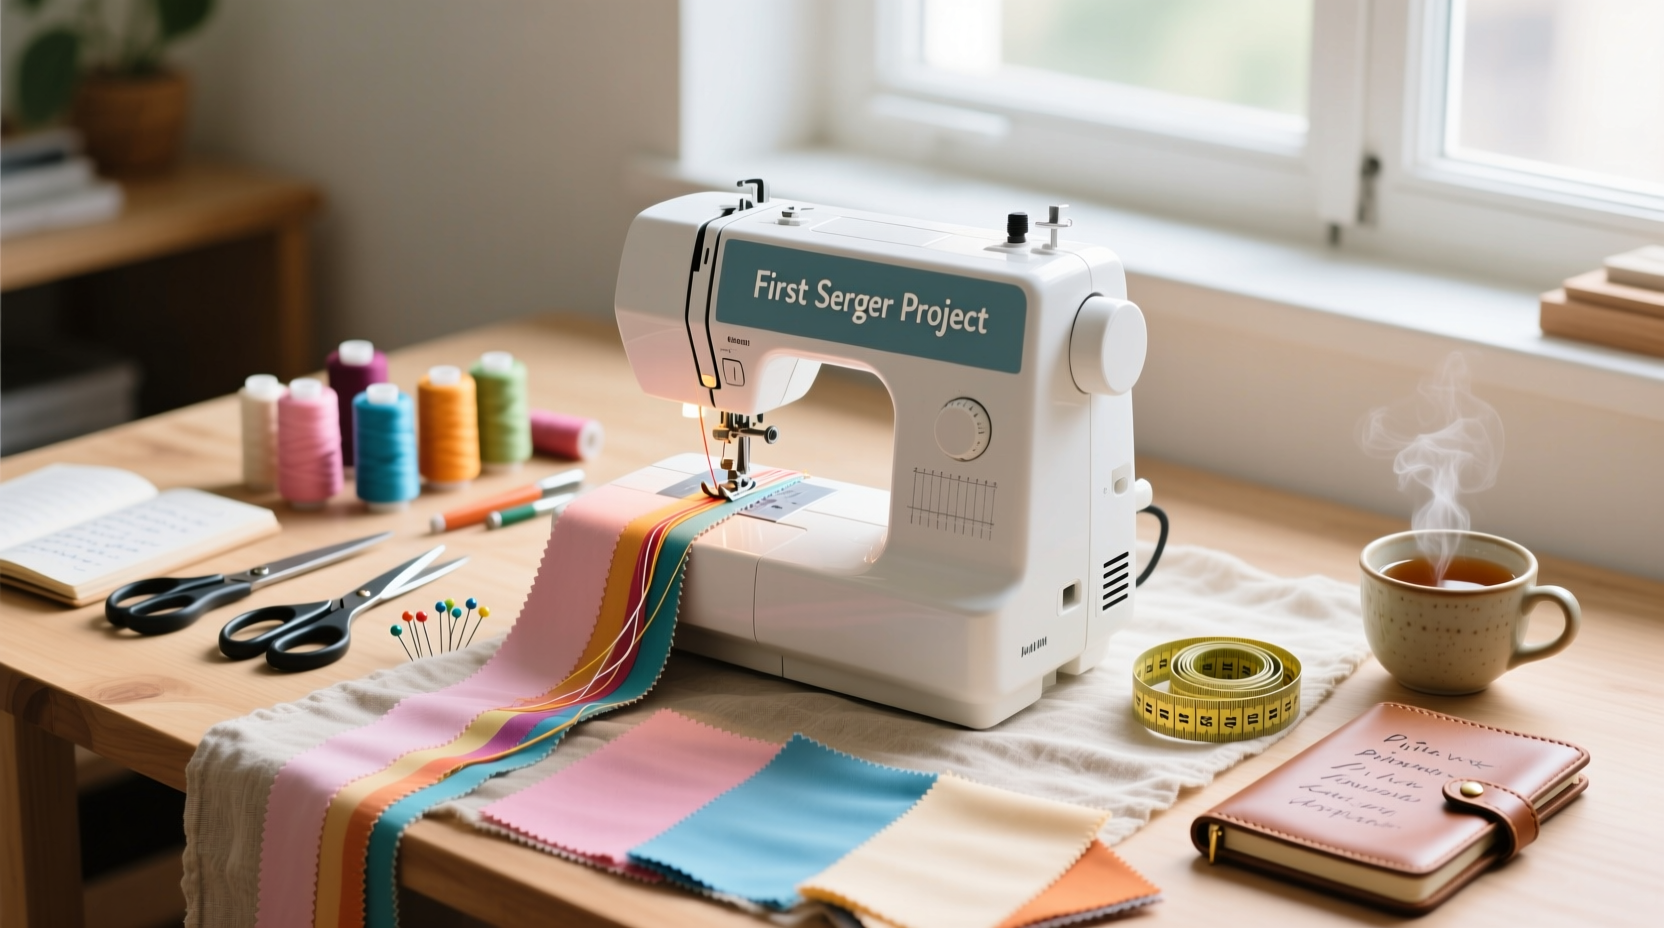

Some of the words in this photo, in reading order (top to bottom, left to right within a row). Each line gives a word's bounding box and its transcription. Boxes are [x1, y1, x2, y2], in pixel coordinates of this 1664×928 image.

[753, 269, 809, 305] First
[814, 279, 894, 325] Serger
[900, 292, 989, 337] Project
